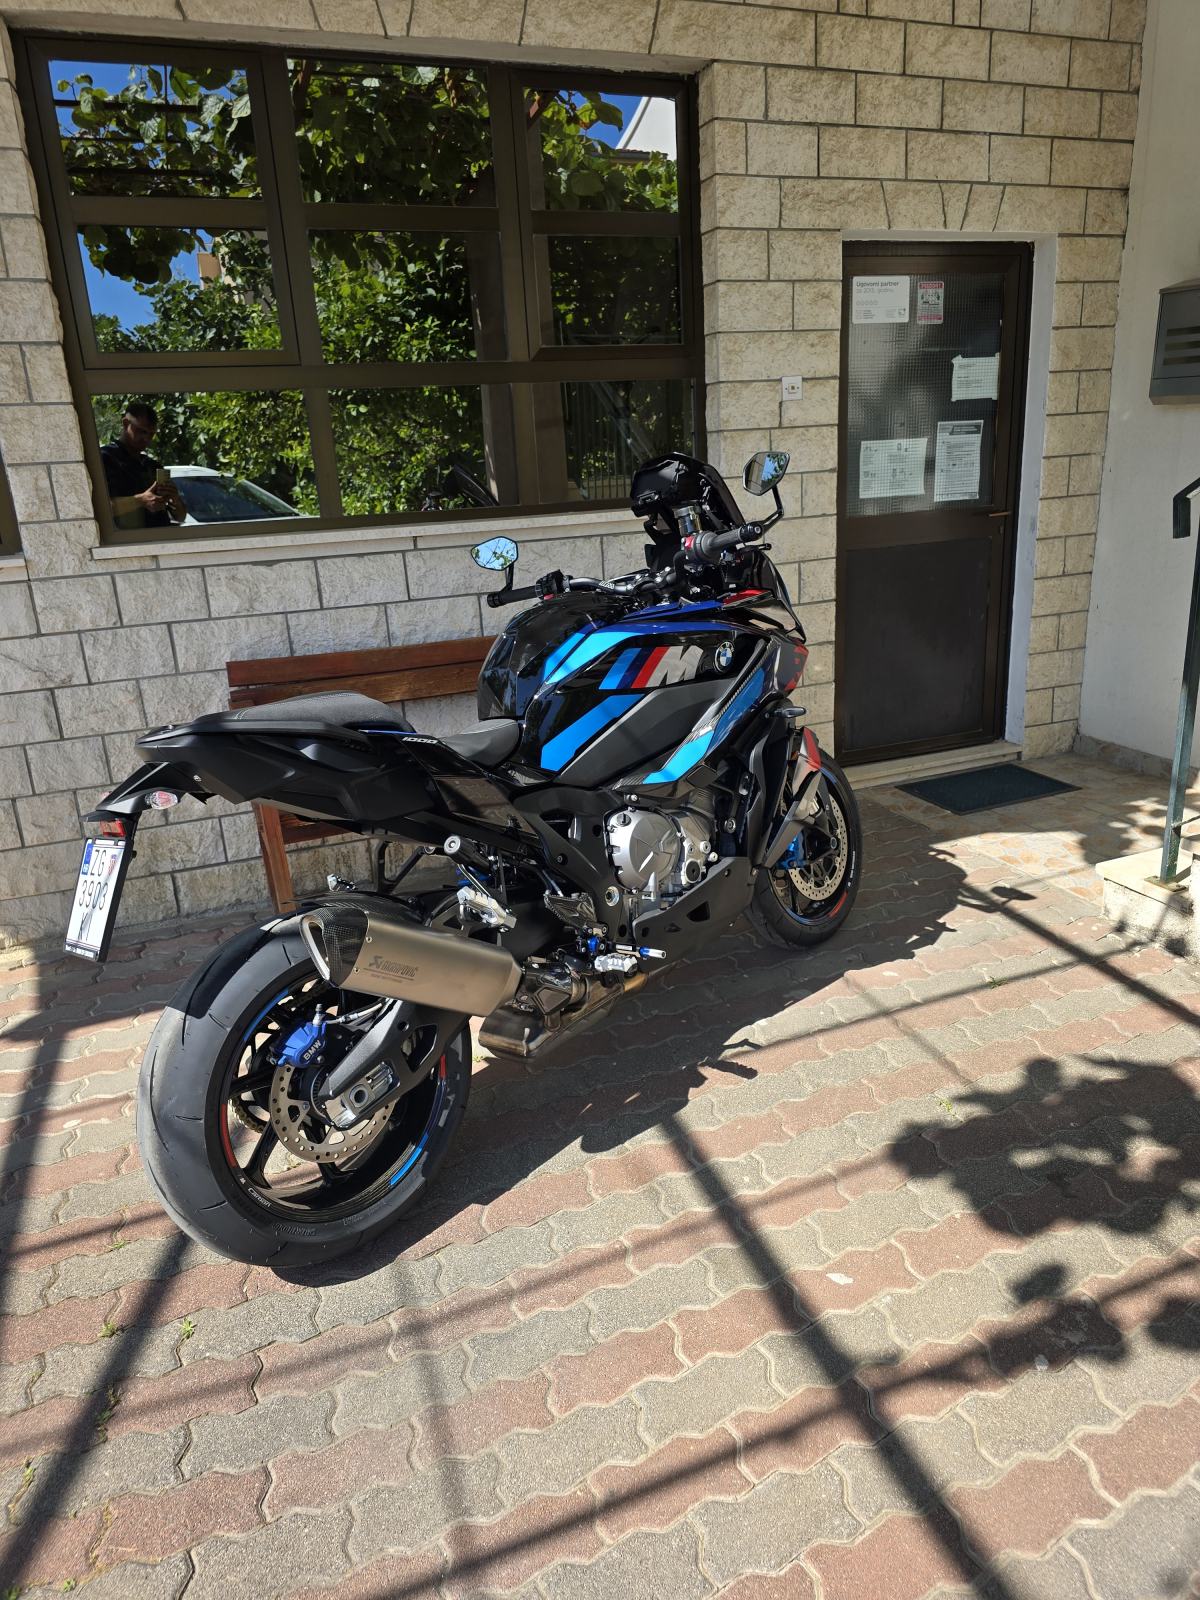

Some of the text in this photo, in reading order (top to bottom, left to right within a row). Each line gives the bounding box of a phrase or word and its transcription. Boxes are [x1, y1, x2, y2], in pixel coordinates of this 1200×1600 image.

[646, 645, 704, 688] M
[402, 736, 438, 744] 1000
[90, 849, 107, 877] ZG
[79, 879, 109, 911] 3903
[303, 1039, 322, 1061] BMW
